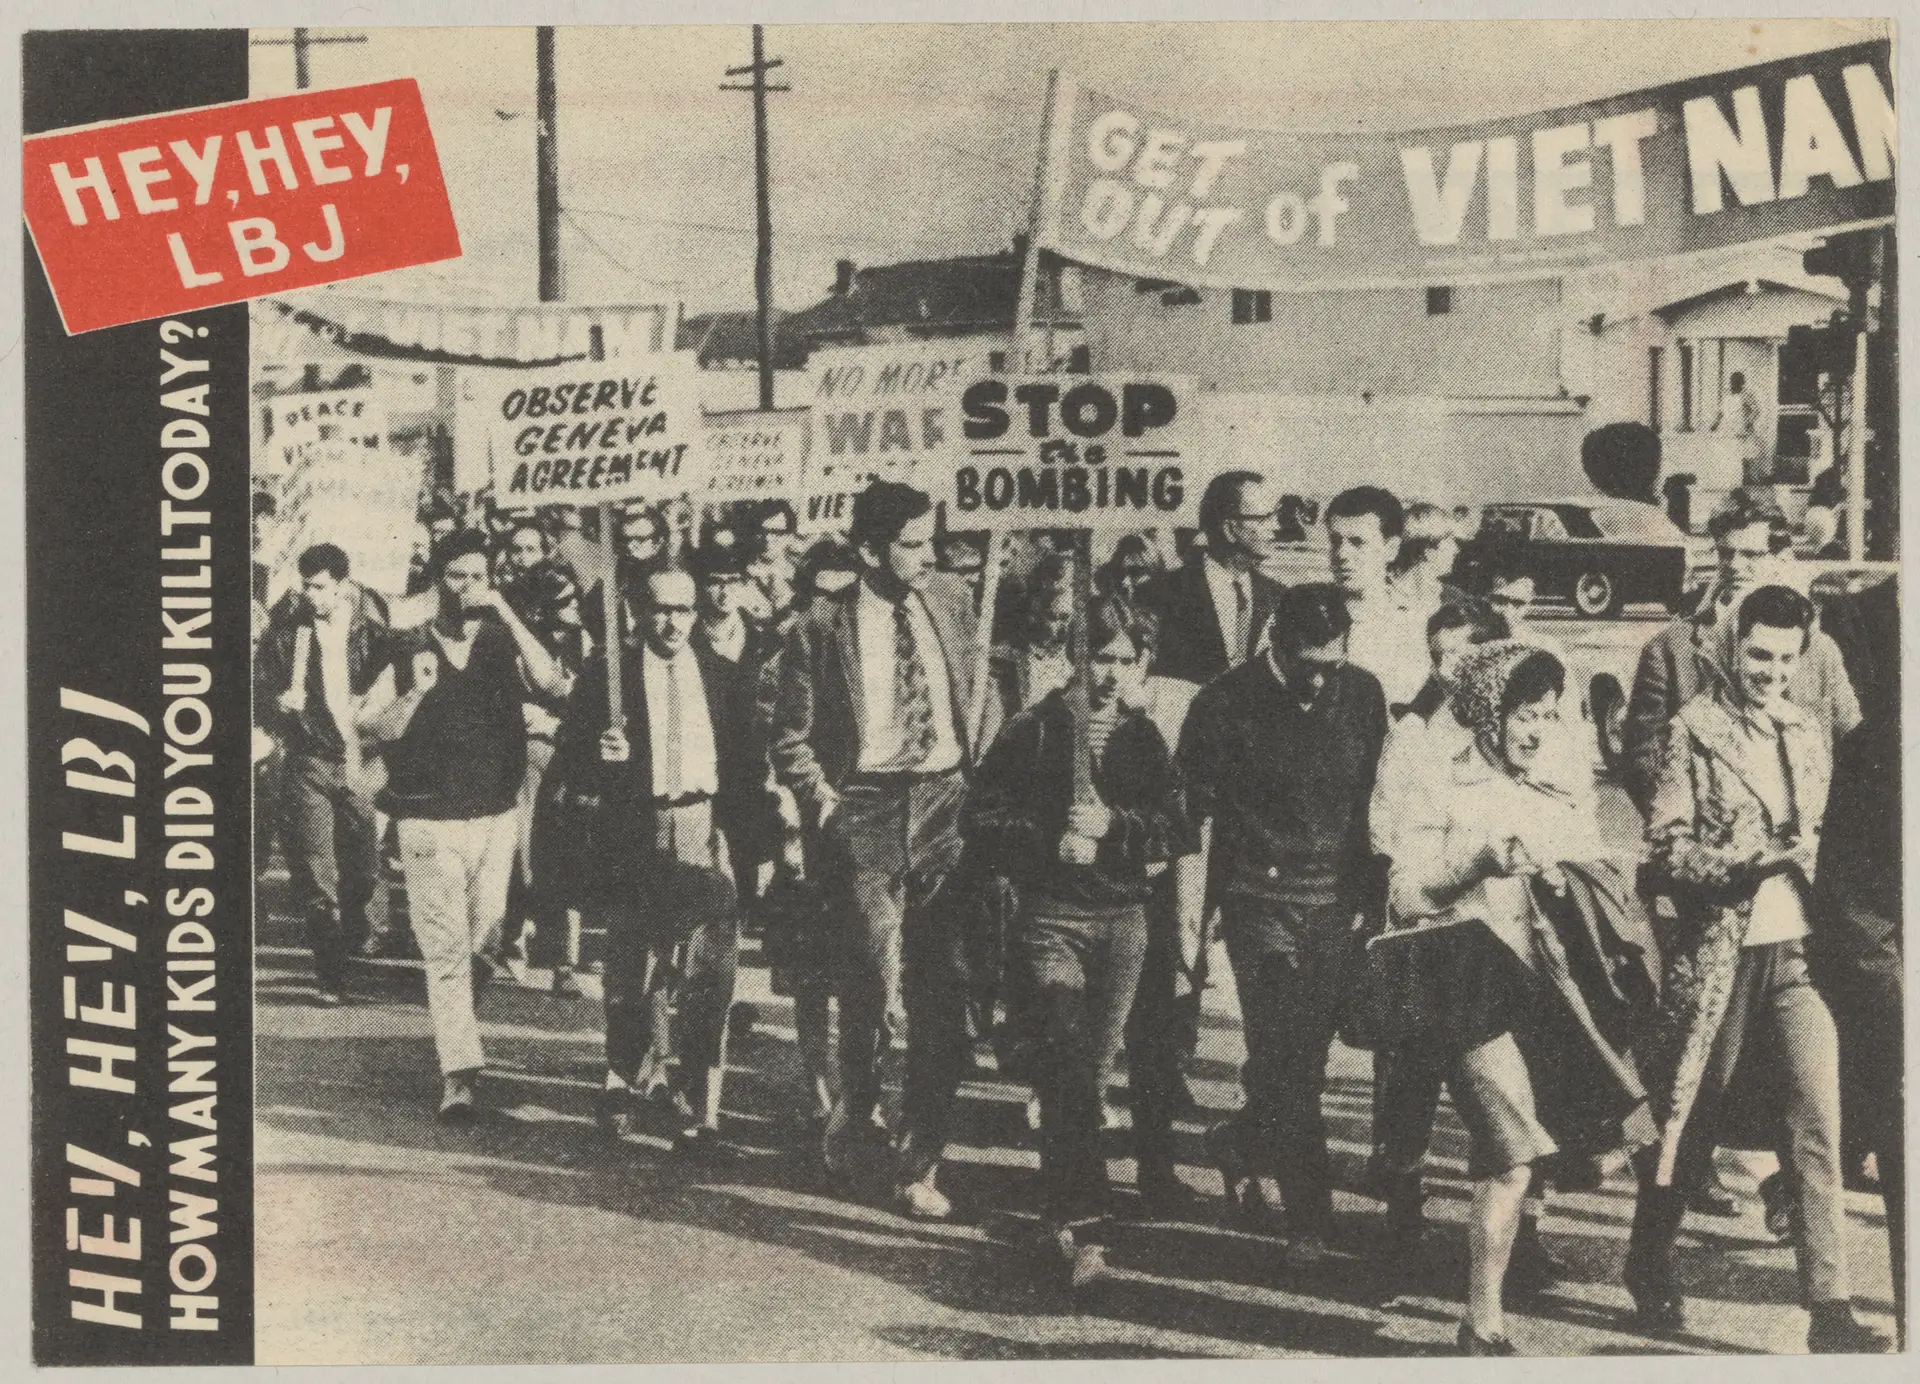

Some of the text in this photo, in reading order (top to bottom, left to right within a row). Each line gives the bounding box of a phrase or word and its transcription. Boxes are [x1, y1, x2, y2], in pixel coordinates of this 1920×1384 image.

[1080, 179, 1244, 266] OUT
[1400, 107, 1657, 246] VIET
[1087, 110, 1247, 197] GET
[167, 203, 346, 289] LBJ
[502, 375, 658, 421] OBSERVE
[514, 411, 667, 456] GENEVA
[961, 380, 1177, 440] STOP
[510, 443, 689, 493] AGREEMENT
[807, 493, 848, 521] VIE
[956, 465, 1185, 513] BOMBING
[162, 663, 214, 778] YOU
[164, 786, 215, 870] DID
[166, 888, 216, 1011] KIDS
[60, 686, 152, 1329] HEY, HEY, LBJ
[168, 1024, 218, 1182] MANY
[169, 1190, 219, 1331] HOW
